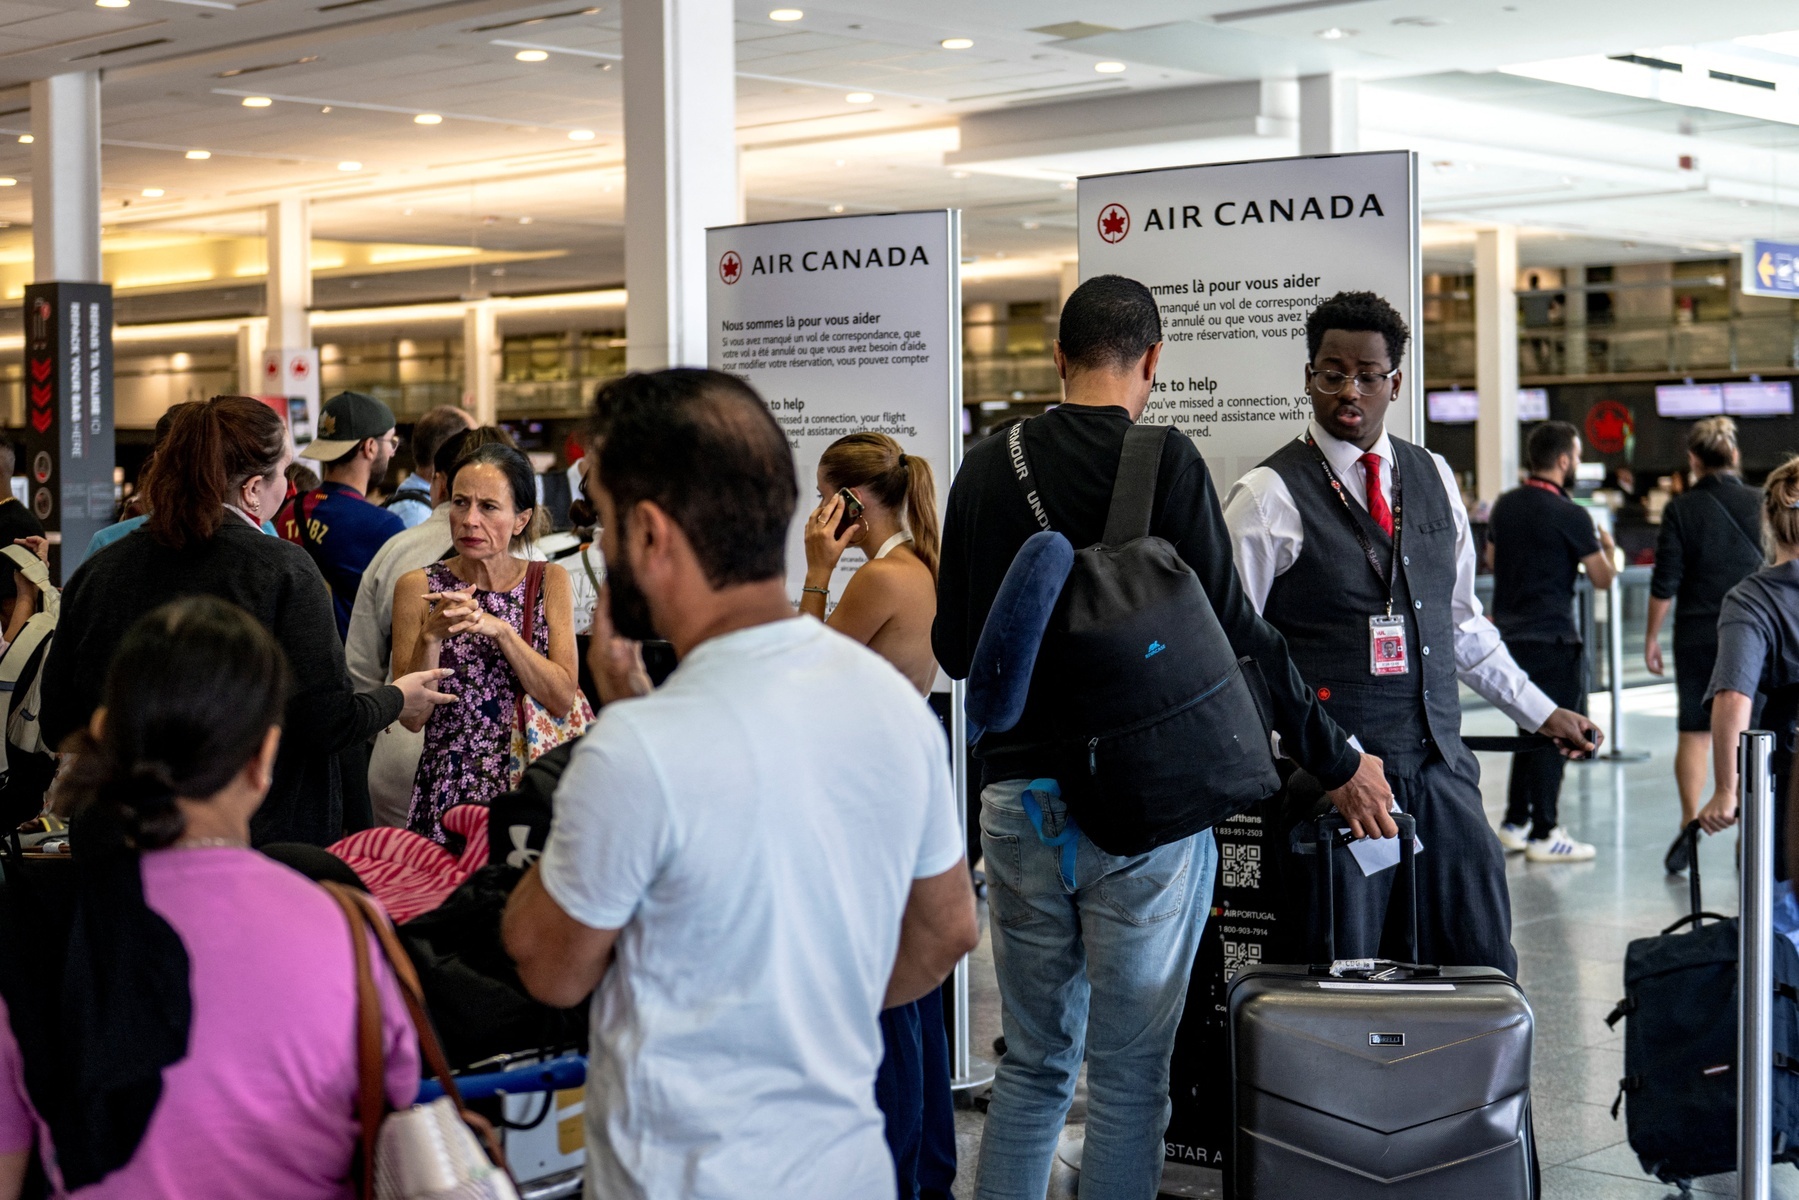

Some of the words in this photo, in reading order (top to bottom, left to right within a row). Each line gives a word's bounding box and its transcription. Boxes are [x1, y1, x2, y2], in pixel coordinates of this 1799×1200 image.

[1144, 205, 1203, 232] AIR
[1214, 193, 1385, 226] CANADA
[752, 254, 793, 275] AIR
[802, 246, 929, 271] CANADA
[1150, 283, 1189, 295] mmes
[1193, 279, 1205, 293] là
[1209, 279, 1241, 296] pour
[1245, 278, 1278, 290] vous
[1283, 273, 1321, 288] aider
[1160, 300, 1200, 315] manqué
[1203, 302, 1216, 311] un
[1219, 298, 1236, 310] vol
[1239, 298, 1252, 309] de
[722, 320, 743, 332] Nous
[746, 319, 783, 331] sommes
[787, 316, 795, 328] là
[798, 316, 821, 330] pour
[825, 315, 849, 326] vous
[852, 312, 881, 324] aider
[1171, 314, 1205, 327] annulé
[1208, 317, 1221, 325] ou
[1225, 315, 1244, 328] que
[1248, 313, 1274, 324] vous
[1277, 312, 1302, 322] avez
[722, 336, 728, 347] Si
[730, 337, 744, 346] vous
[746, 336, 761, 345] avez
[763, 333, 791, 347] manqué
[794, 334, 804, 343] un
[806, 332, 817, 342] vol
[820, 331, 830, 342] de
[832, 329, 901, 344] correspondance,
[904, 330, 921, 344] que
[1167, 331, 1194, 342] votre
[1196, 328, 1259, 340] réservation,
[1261, 328, 1288, 338] vous
[722, 349, 739, 359] votre
[740, 348, 750, 358] vol
[752, 349, 757, 358] a
[758, 346, 770, 357] été
[771, 345, 795, 356] annulé
[798, 347, 807, 355] ou
[810, 346, 824, 358] que
[827, 344, 846, 353] vous
[848, 343, 867, 353] avez
[869, 341, 897, 352] besoin
[900, 341, 926, 351] d'aide
[722, 361, 737, 372] pour
[739, 358, 767, 370] modifier
[769, 358, 787, 369] votre
[789, 356, 834, 369] réservation,
[837, 357, 856, 366] vous
[858, 355, 889, 368] pouvez
[891, 354, 929, 367] compter
[1171, 380, 1185, 392] to
[1189, 376, 1218, 394] help
[771, 400, 781, 410] to
[783, 397, 805, 413] help
[1145, 398, 1176, 413] you've
[1179, 396, 1214, 408] missed
[1217, 399, 1224, 407] a
[1226, 395, 1291, 407] connection,
[777, 414, 802, 424] missed
[804, 416, 809, 424] a
[811, 413, 858, 424] connection,
[860, 414, 880, 425] your
[883, 412, 906, 425] flight
[1158, 415, 1168, 424] or
[1171, 414, 1190, 426] you
[1193, 411, 1218, 423] need
[1221, 410, 1276, 422] assistance
[1279, 408, 1304, 420] with
[786, 426, 805, 436] need
[807, 426, 847, 436] assistance
[871, 424, 918, 437] rebooking,
[1180, 425, 1212, 438] vered.
[1009, 422, 1029, 480] ARMOUR
[1220, 827, 1263, 837] 833-951-2503
[1223, 925, 1268, 936] 800-903-7914
[1166, 1142, 1207, 1162] STAR
